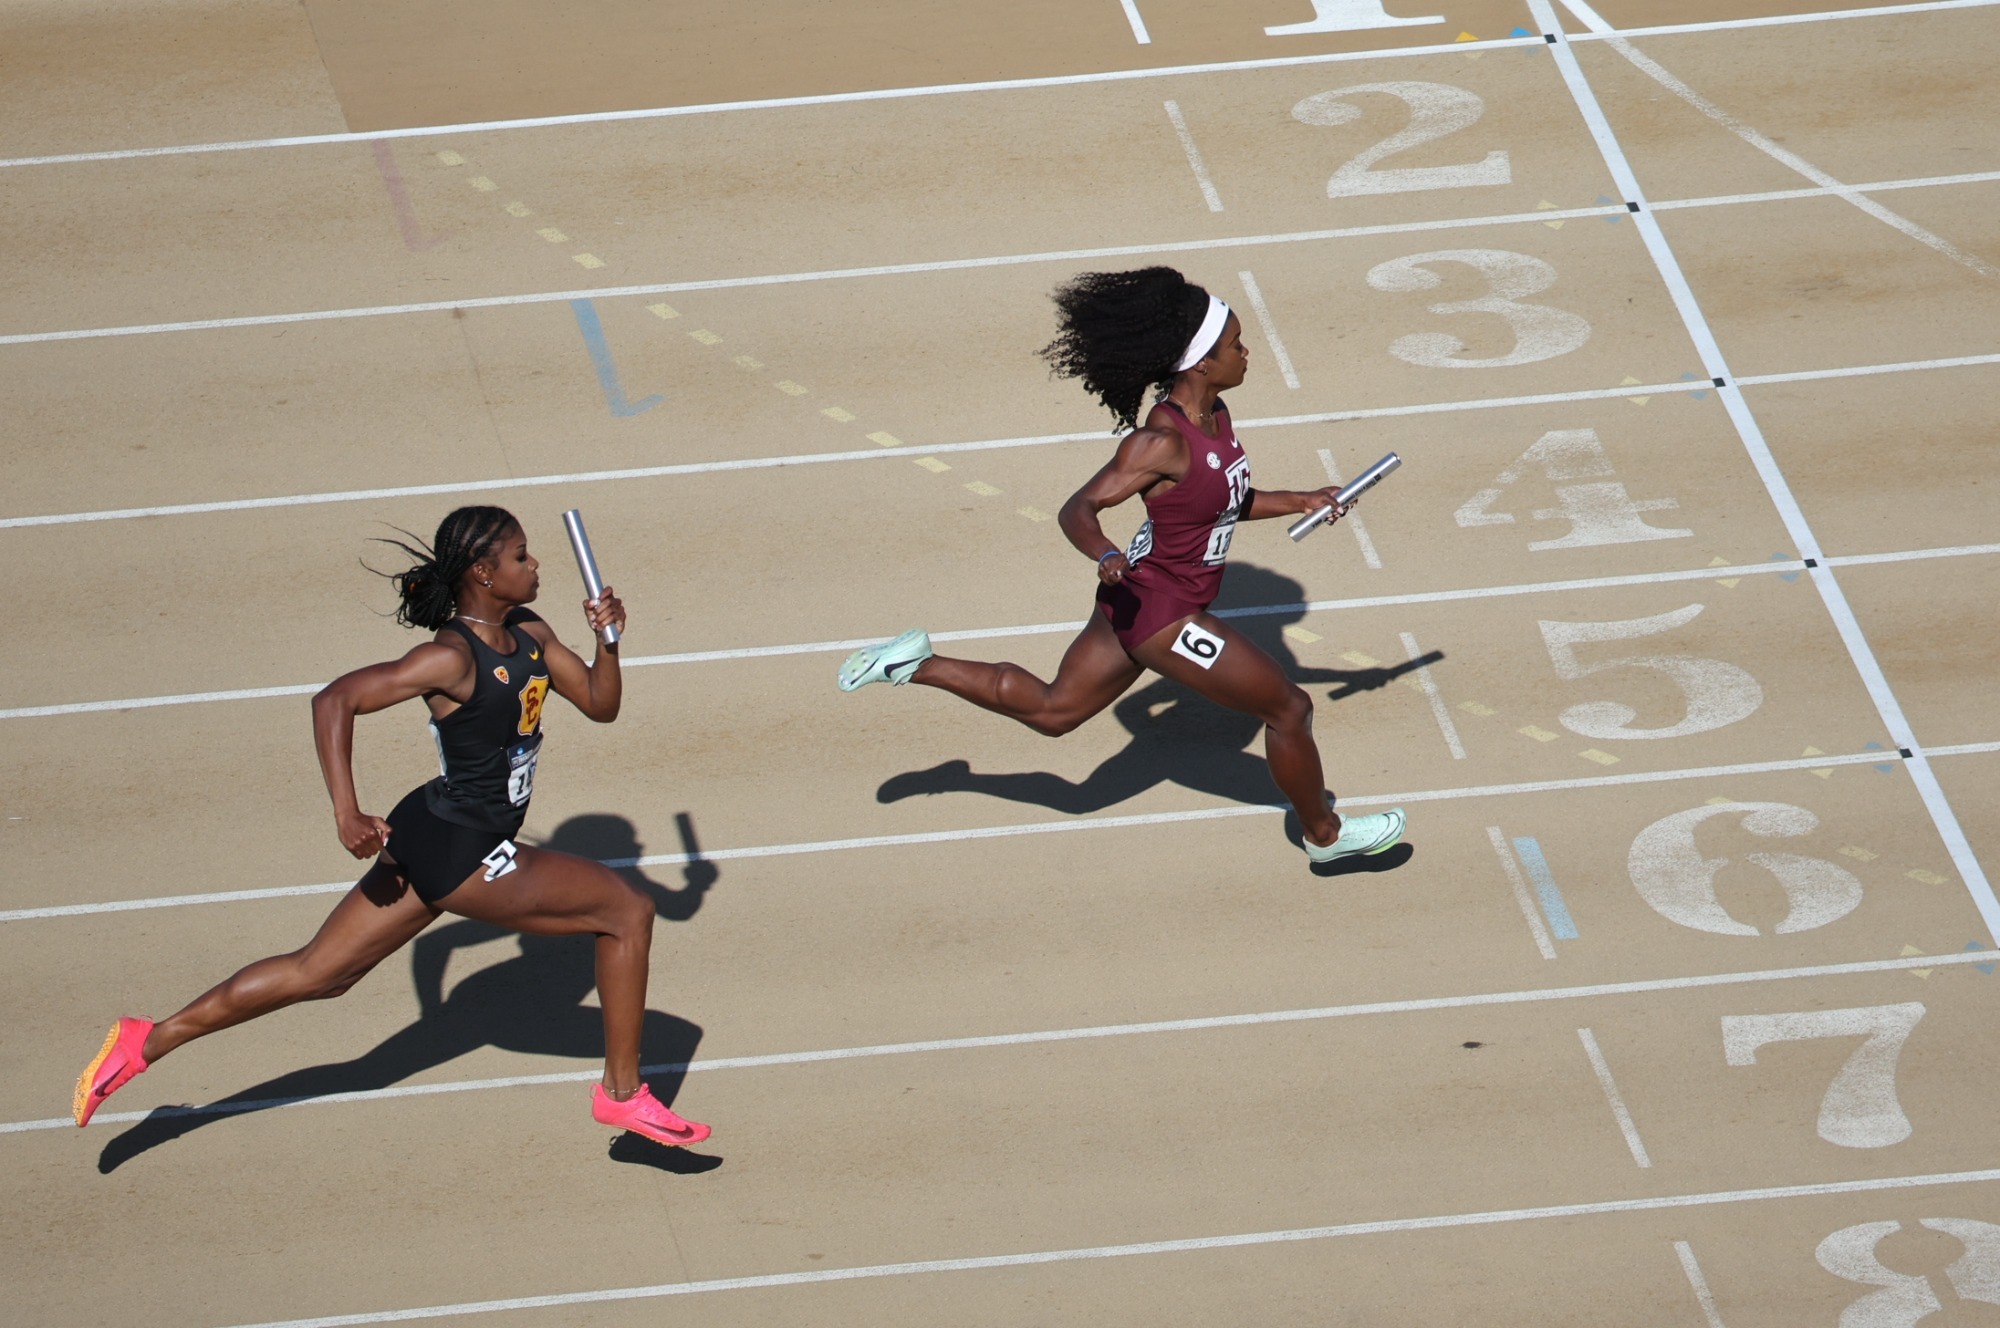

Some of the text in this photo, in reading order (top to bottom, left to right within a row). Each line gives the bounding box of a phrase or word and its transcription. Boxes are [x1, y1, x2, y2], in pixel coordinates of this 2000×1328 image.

[1291, 81, 1511, 199] 2
[1366, 249, 1592, 368] 3
[1453, 427, 1694, 551] 4
[1181, 629, 1218, 660] 6
[1537, 604, 1764, 740] 5
[1627, 802, 1864, 936] 6
[1721, 1001, 1926, 1149] 7
[1815, 1217, 2000, 1328] 8
